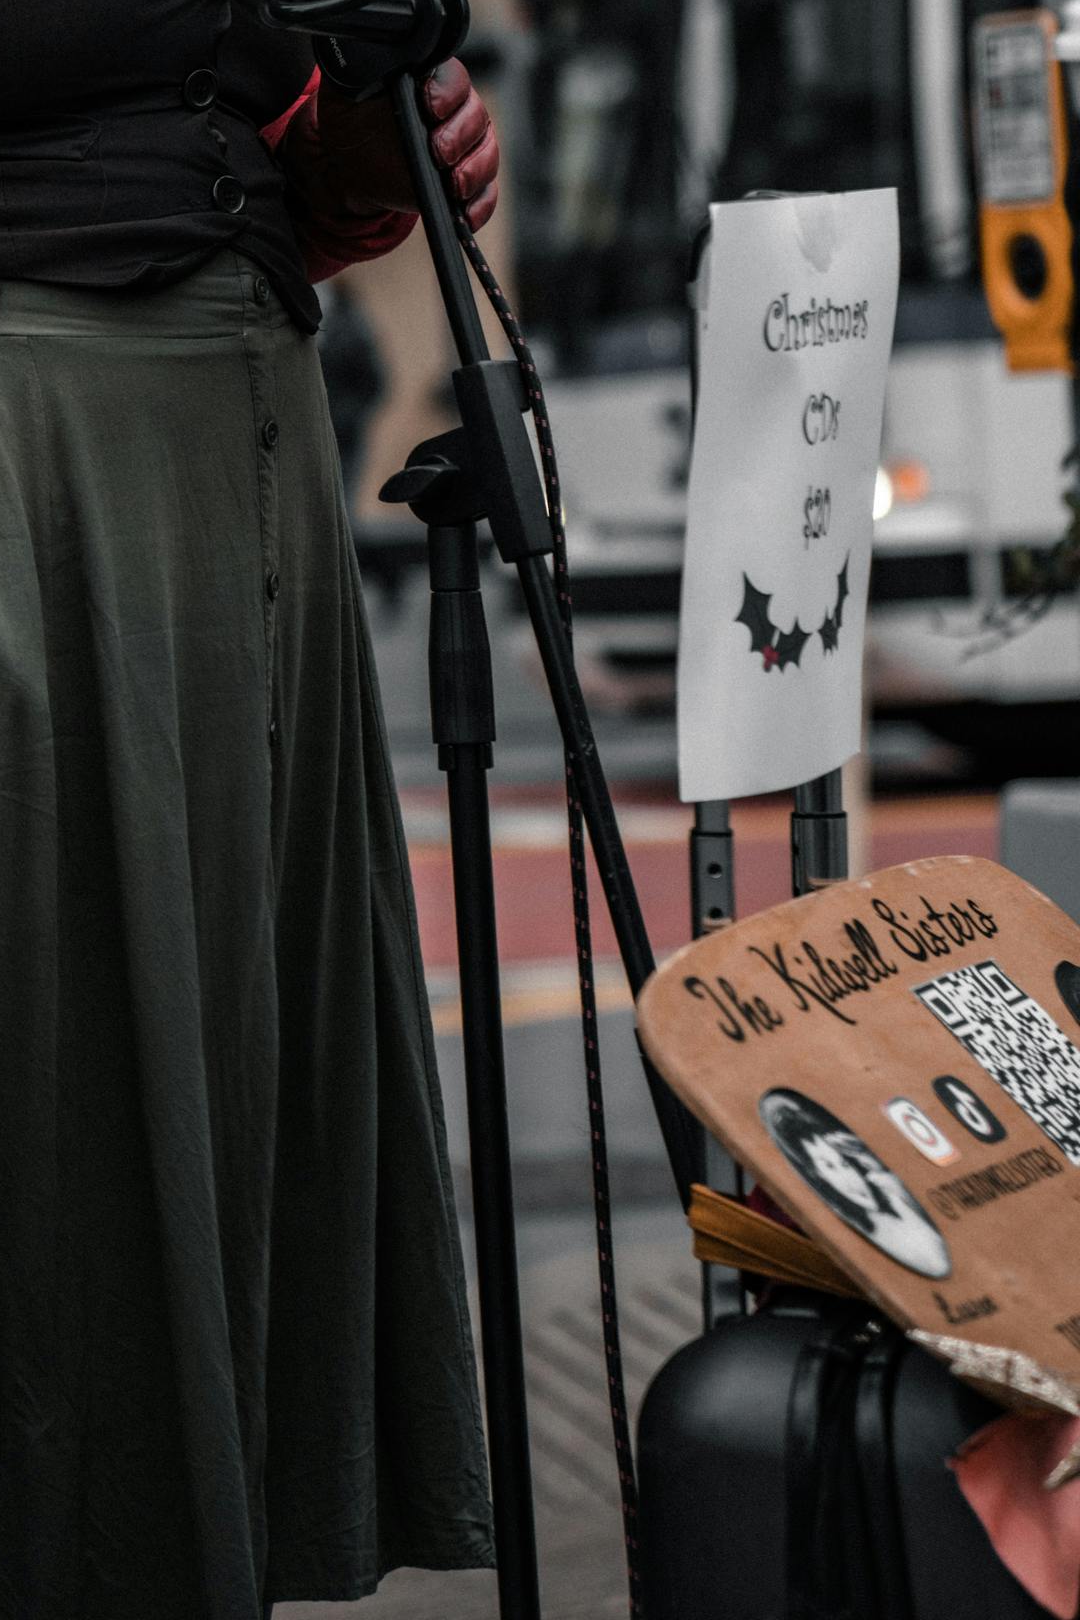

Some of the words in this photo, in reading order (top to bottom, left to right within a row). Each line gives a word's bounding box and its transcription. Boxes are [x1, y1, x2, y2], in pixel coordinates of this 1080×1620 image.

[764, 293, 868, 352] Christmas
[803, 392, 840, 445] CDs
[684, 977, 783, 1042] The
[748, 918, 898, 1025] Kidwell
[872, 895, 998, 962] Sisters
